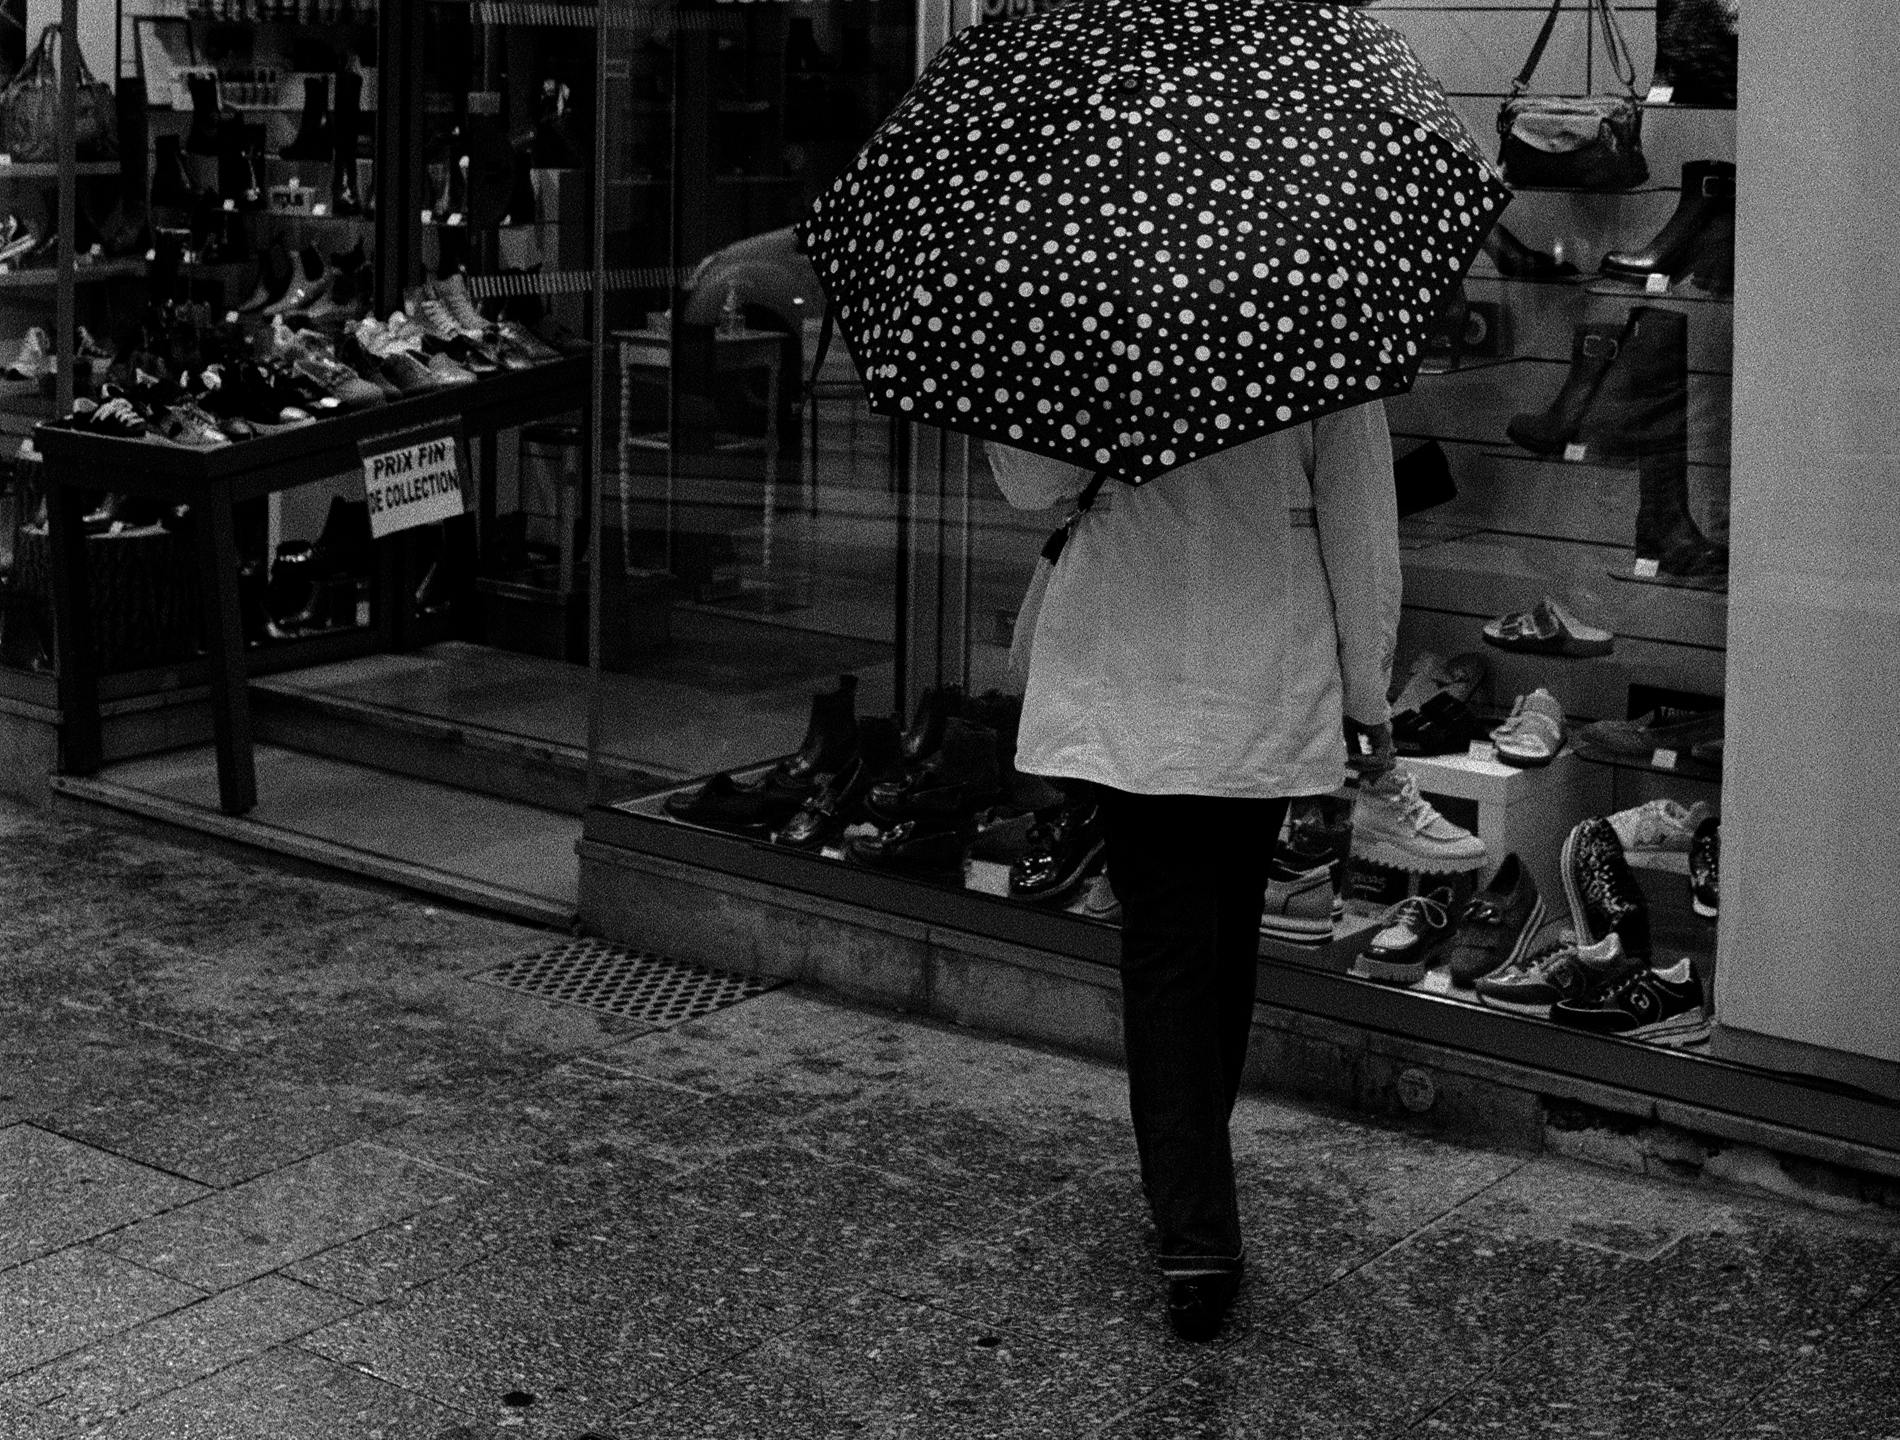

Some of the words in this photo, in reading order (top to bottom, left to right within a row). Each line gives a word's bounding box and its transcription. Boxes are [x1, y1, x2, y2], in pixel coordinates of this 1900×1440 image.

[372, 450, 413, 480] PRIX
[418, 441, 446, 468] FIN
[385, 468, 461, 509] COLLECTION
